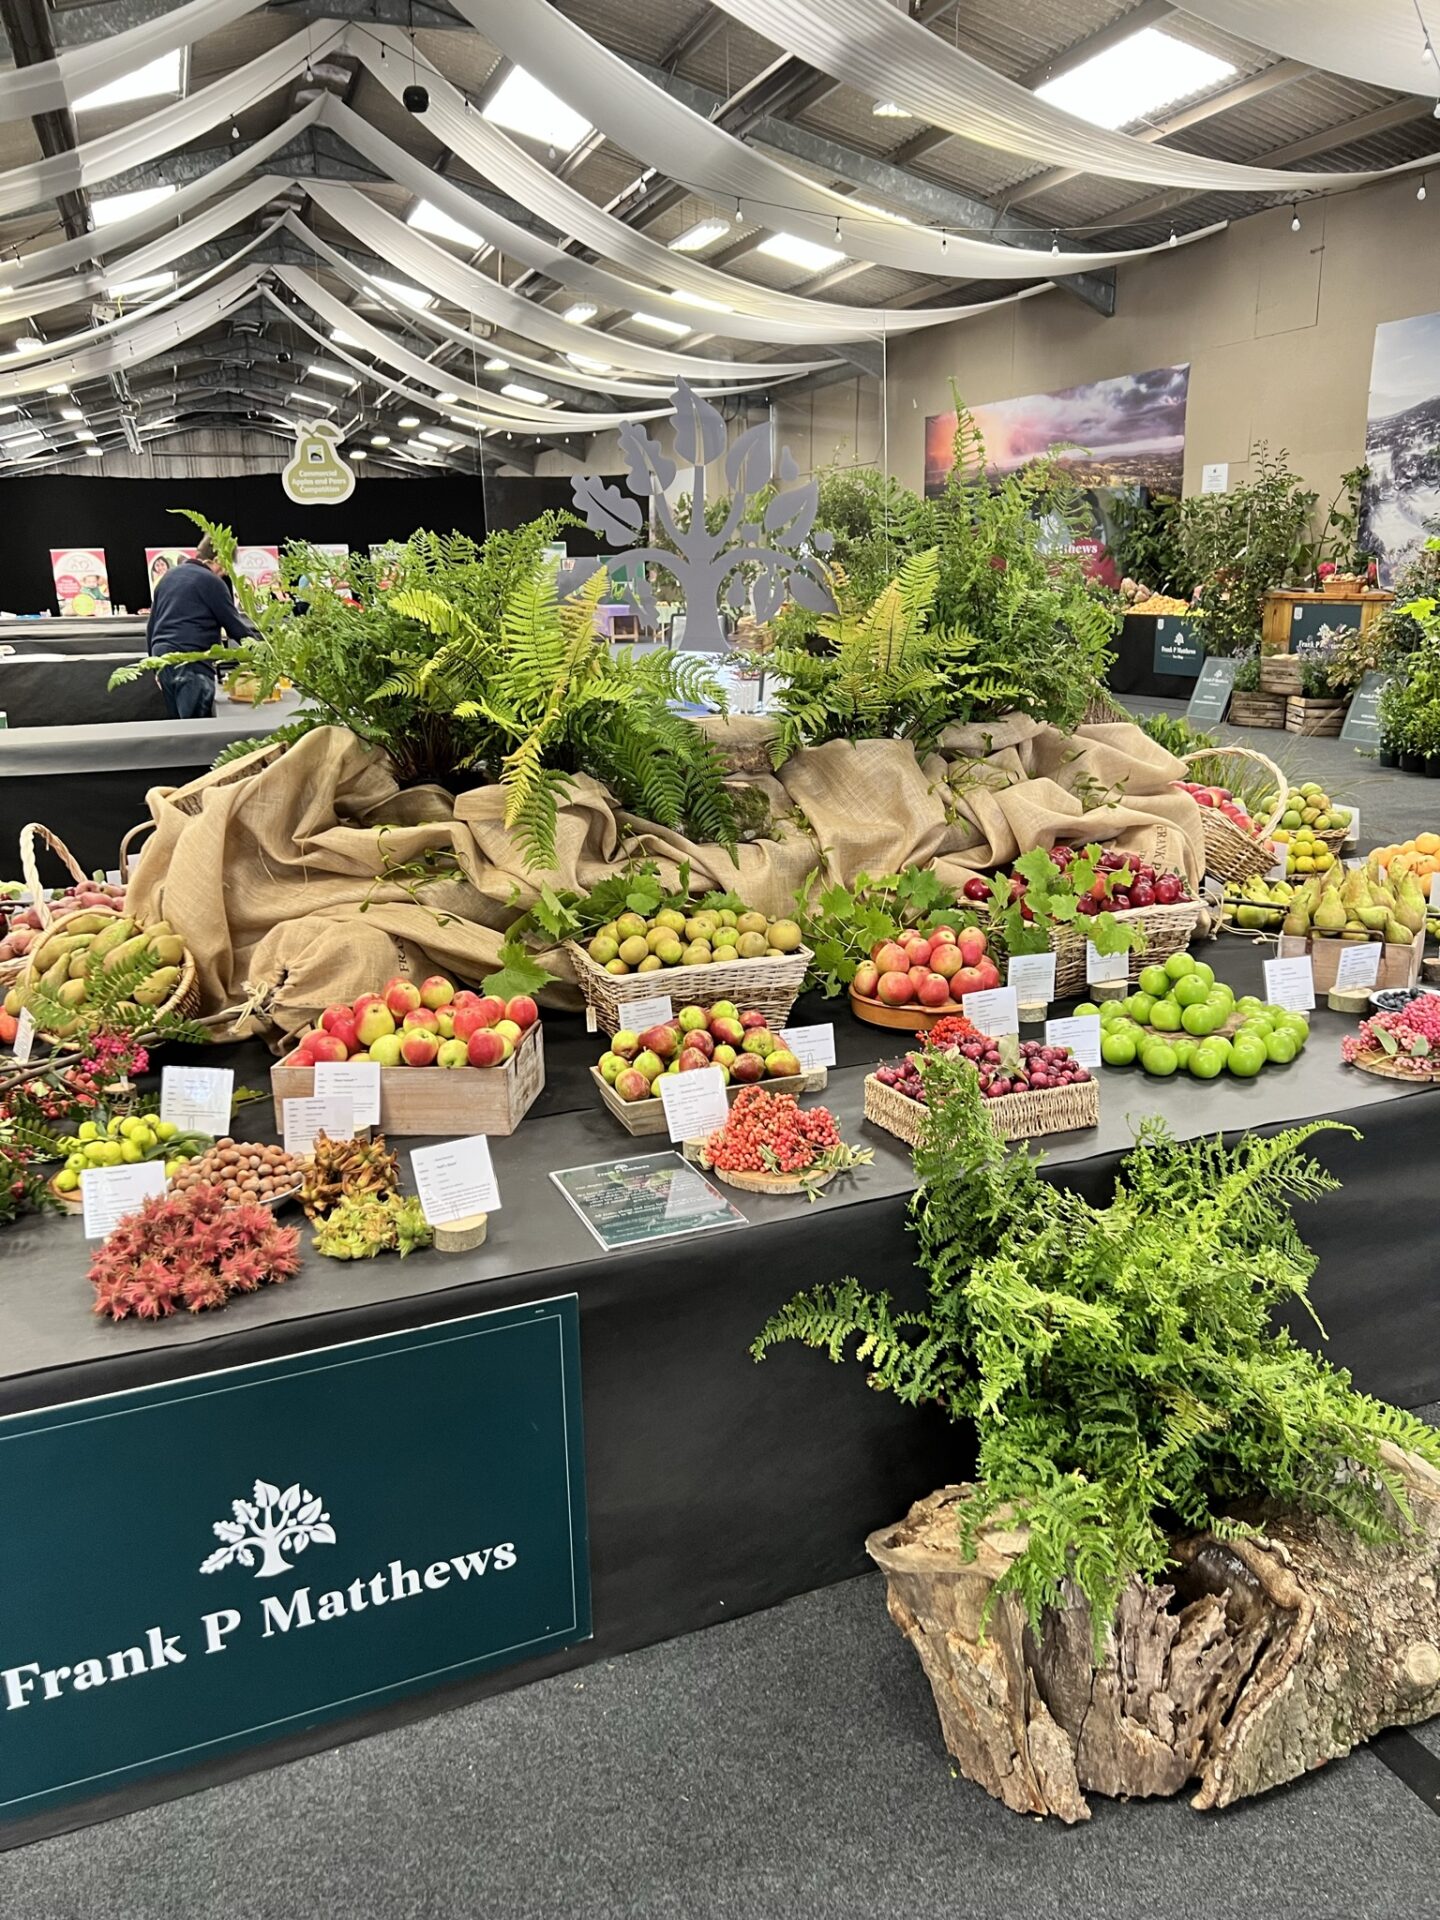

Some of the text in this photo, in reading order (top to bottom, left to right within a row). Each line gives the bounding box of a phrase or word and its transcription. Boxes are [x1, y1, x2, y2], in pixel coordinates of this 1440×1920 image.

[299, 470, 338, 478] Commercial
[292, 478, 347, 487] Apples and Pears
[300, 486, 340, 494] Competition
[1152, 861, 1162, 871] P
[395, 935, 410, 973] FRA
[1, 1542, 517, 1711] Frank P Matthews
